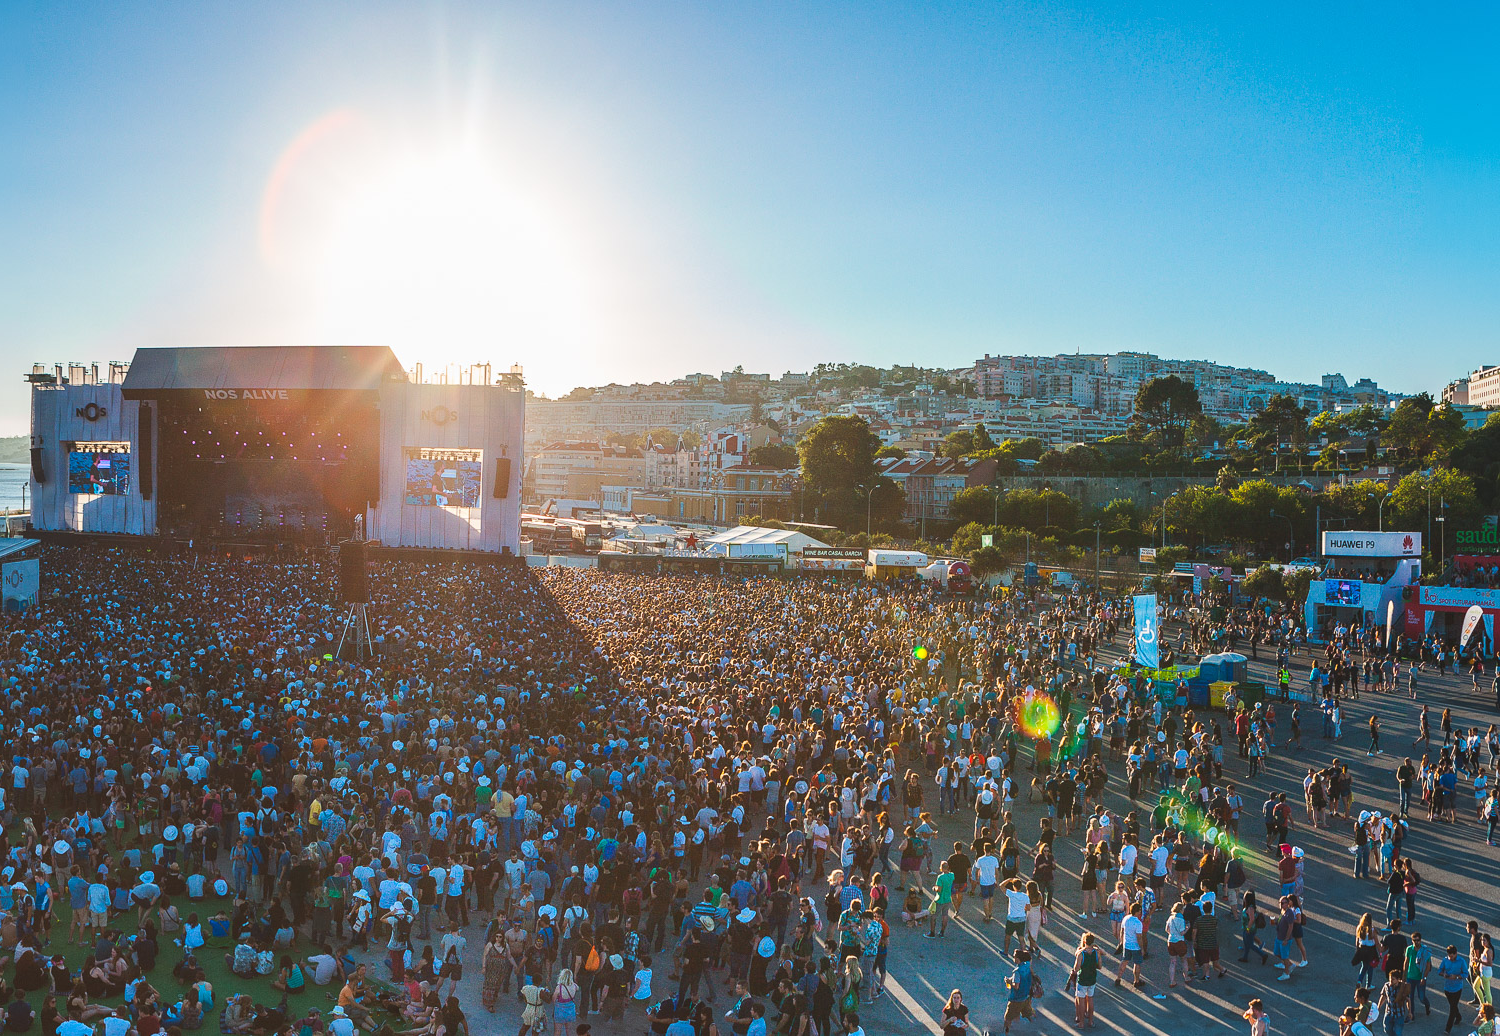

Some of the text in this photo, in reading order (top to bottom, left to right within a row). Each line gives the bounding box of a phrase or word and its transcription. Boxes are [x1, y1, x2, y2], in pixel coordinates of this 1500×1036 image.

[204, 390, 288, 399] NOS ALIVE
[76, 403, 107, 421] NOS
[421, 405, 458, 426] NOS
[1330, 540, 1375, 548] HUAWEI P9
[6, 570, 24, 588] NOS
